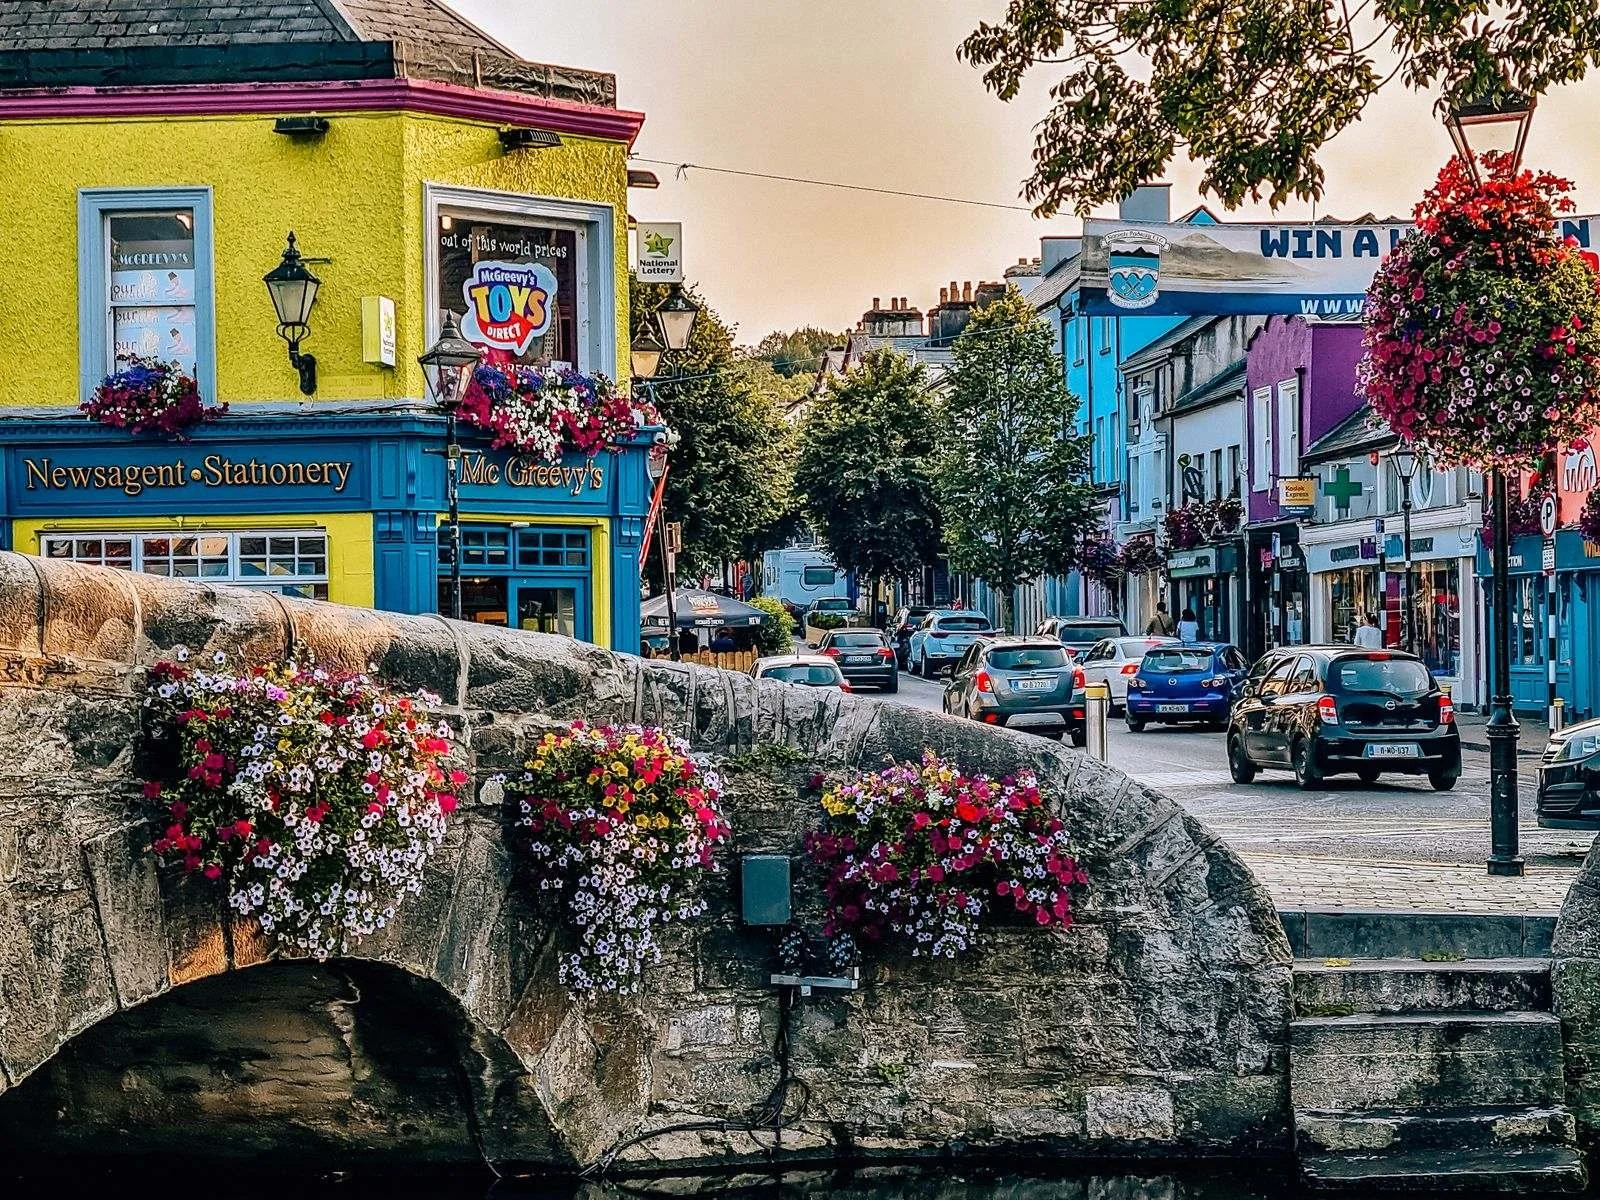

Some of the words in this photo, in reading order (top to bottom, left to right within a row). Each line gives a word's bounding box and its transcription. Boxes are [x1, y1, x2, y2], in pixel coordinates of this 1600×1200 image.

[441, 234, 458, 248] out
[462, 234, 472, 251] of
[477, 234, 497, 251] this
[499, 240, 531, 257] world
[535, 244, 567, 258] prices
[1260, 229, 1342, 259] WIN
[1352, 229, 1380, 258] A
[640, 259, 678, 267] National
[642, 267, 676, 276] Lottery
[480, 270, 536, 287] McGreevy's
[470, 284, 547, 328] TOYS
[486, 323, 522, 340] DIRECT
[24, 458, 186, 495] Newsagent
[204, 455, 351, 491] Stationery
[504, 456, 604, 496] Greevy's
